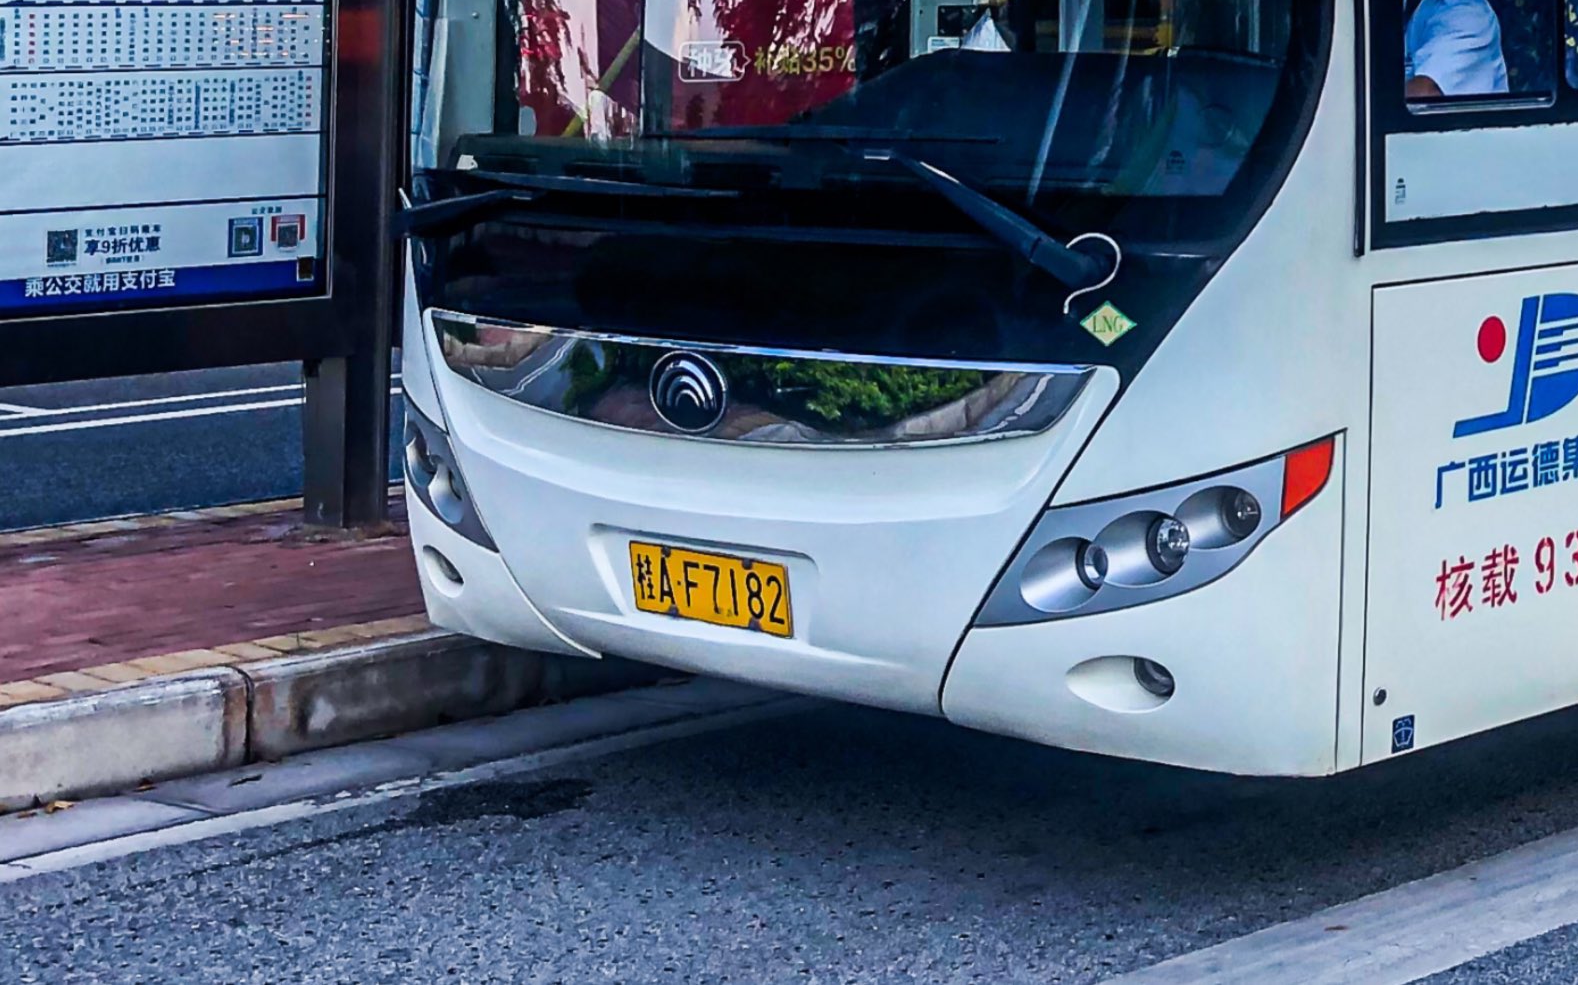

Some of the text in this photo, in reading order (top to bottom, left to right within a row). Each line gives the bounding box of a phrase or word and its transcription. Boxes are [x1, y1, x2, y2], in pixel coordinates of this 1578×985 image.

[84, 236, 161, 256] 享9折优惠
[24, 269, 176, 298] 乘公交就用支付宝
[1092, 314, 1124, 334] LNG
